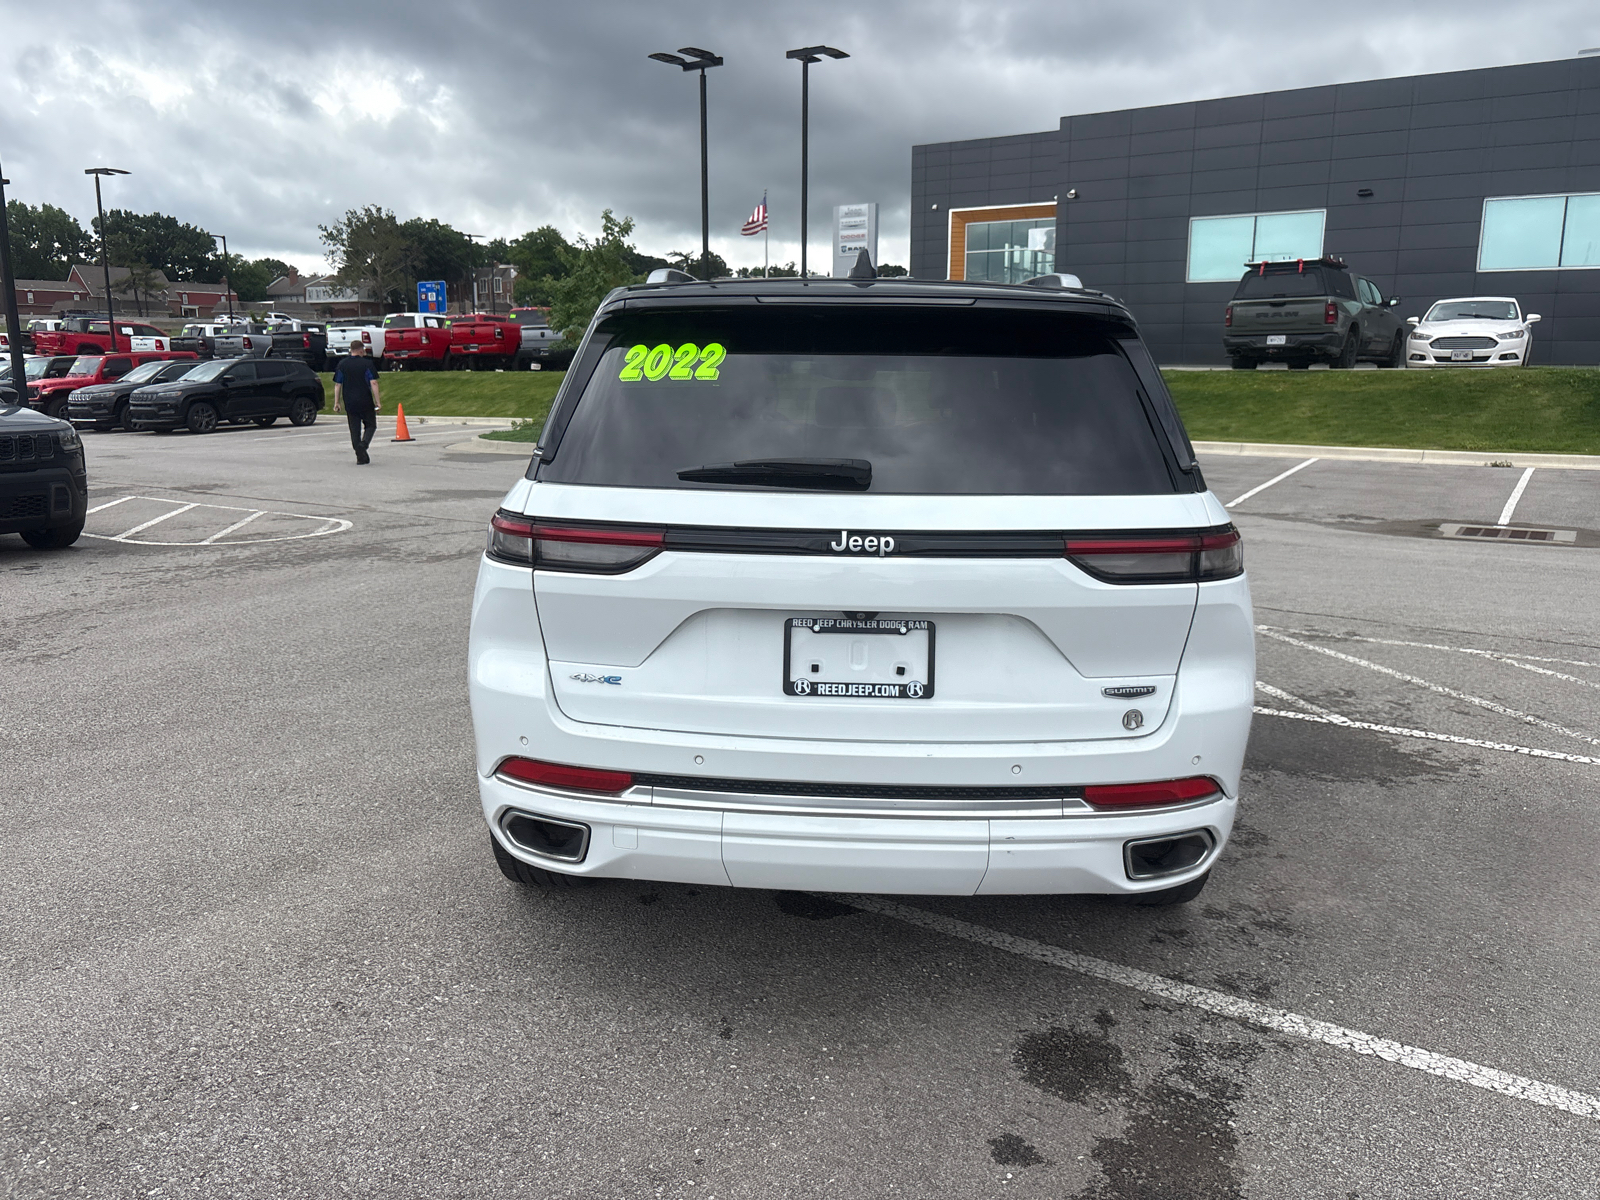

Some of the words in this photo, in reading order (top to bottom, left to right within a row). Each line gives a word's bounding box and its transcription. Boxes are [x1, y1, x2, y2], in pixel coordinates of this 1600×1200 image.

[1255, 311, 1300, 319] RAM
[618, 342, 727, 382] 2022
[830, 530, 895, 557] Jeep
[792, 618, 812, 627] REED
[816, 619, 834, 628] JEEP
[836, 619, 877, 629] CHRYSLER
[879, 620, 906, 629] DODGE
[908, 621, 928, 630] RAM
[817, 684, 899, 697] REEDJEEP.COM
[1105, 686, 1154, 695] SUMMIT
